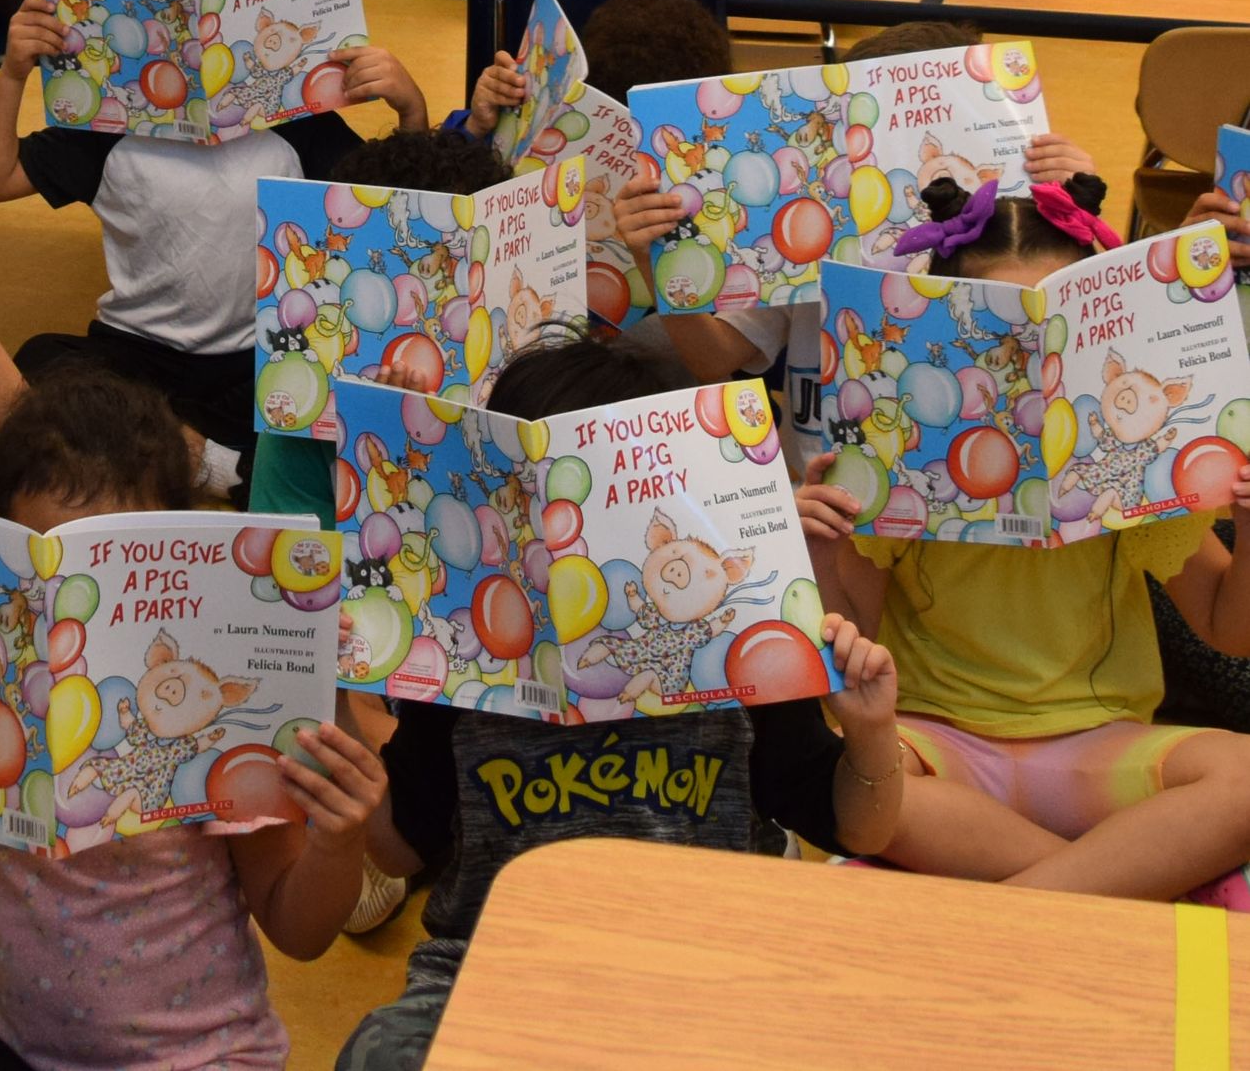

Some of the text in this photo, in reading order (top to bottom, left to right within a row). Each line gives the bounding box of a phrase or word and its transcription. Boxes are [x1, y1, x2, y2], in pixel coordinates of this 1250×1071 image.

[312, 0, 351, 18] Felicia Bond
[866, 60, 963, 87] IF YOU GIVE
[893, 84, 942, 106] A PIG
[888, 103, 953, 131] A PARTY
[595, 149, 639, 181] PARTY
[483, 185, 541, 220] IF YOU GIVE
[498, 212, 527, 239] A PIG
[493, 234, 533, 267] A PARTY
[1058, 260, 1146, 307] IF YOU GIVE
[1079, 292, 1124, 325] A PIG
[1075, 312, 1136, 354] A PARTY
[1156, 315, 1225, 342] Laura Numeroff
[1178, 349, 1232, 370] Felicia Bond
[575, 408, 695, 450] IF YOU GIVE
[612, 442, 673, 474] A PIG
[604, 469, 688, 509] A PARTY
[713, 480, 778, 507] Laura Numeroff
[740, 507, 774, 520] ILLUSTRATED
[1131, 493, 1199, 516] SCHOLASTIC
[738, 518, 788, 540] Felicia Bond
[90, 540, 227, 568] IF YOU GIVE
[122, 570, 189, 595] A PIG
[109, 596, 204, 627] A PARTY
[227, 623, 316, 640] Laura Numeroff
[254, 647, 304, 657] ILLUSTRATED
[247, 659, 316, 675] Felicia Bond
[675, 685, 755, 703] SCHOLASTIC
[151, 801, 232, 820] SCHOLASTIC
